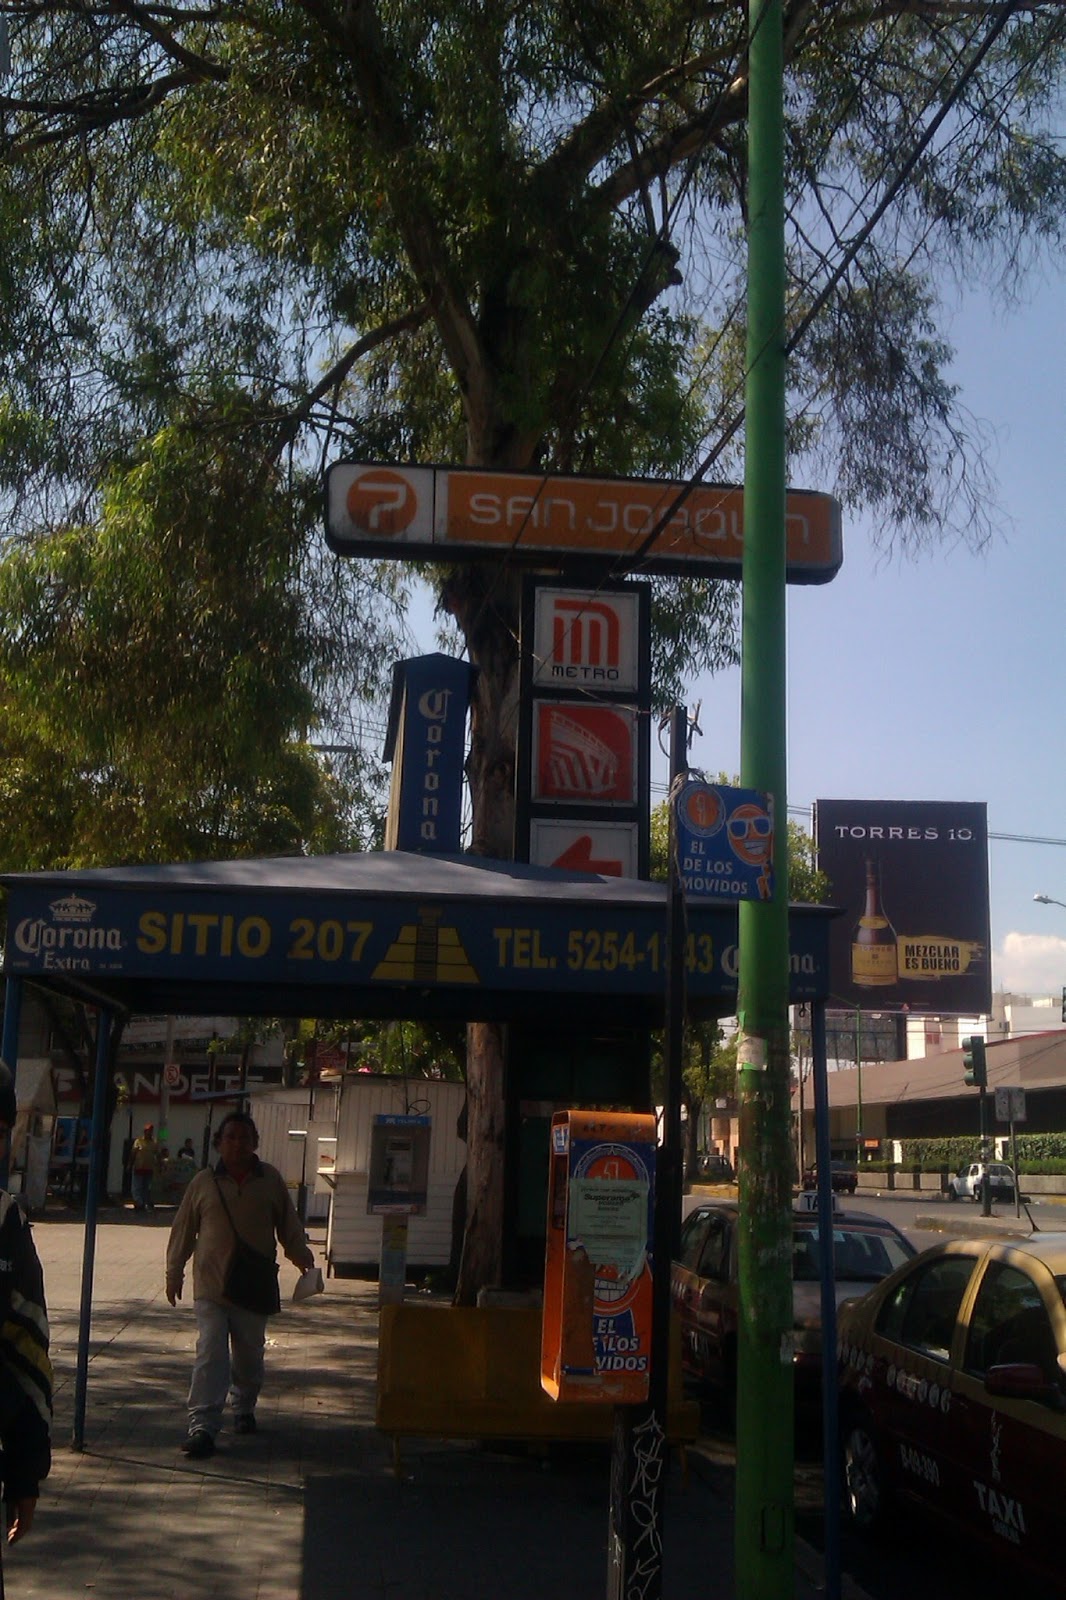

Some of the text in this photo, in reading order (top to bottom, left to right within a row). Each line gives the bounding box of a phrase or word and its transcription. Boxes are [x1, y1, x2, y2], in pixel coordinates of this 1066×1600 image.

[468, 491, 575, 531] SAN
[551, 665, 620, 681] METRO
[418, 688, 452, 841] Corona
[834, 825, 939, 841] TORRES
[690, 841, 706, 856] EL
[683, 859, 734, 875] DE LOS
[681, 876, 749, 895] MOVIDOS
[14, 917, 124, 957] Corona
[136, 911, 376, 962] SITIO 207
[493, 927, 714, 975] TEL. 5254-143
[905, 945, 960, 958] MEZCLAR
[43, 951, 92, 972] Extra
[905, 958, 920, 970] ES
[921, 958, 960, 971] BUENO
[597, 1318, 617, 1334] EL
[608, 1336, 640, 1352] LOS
[972, 1479, 1027, 1536] TAXI
